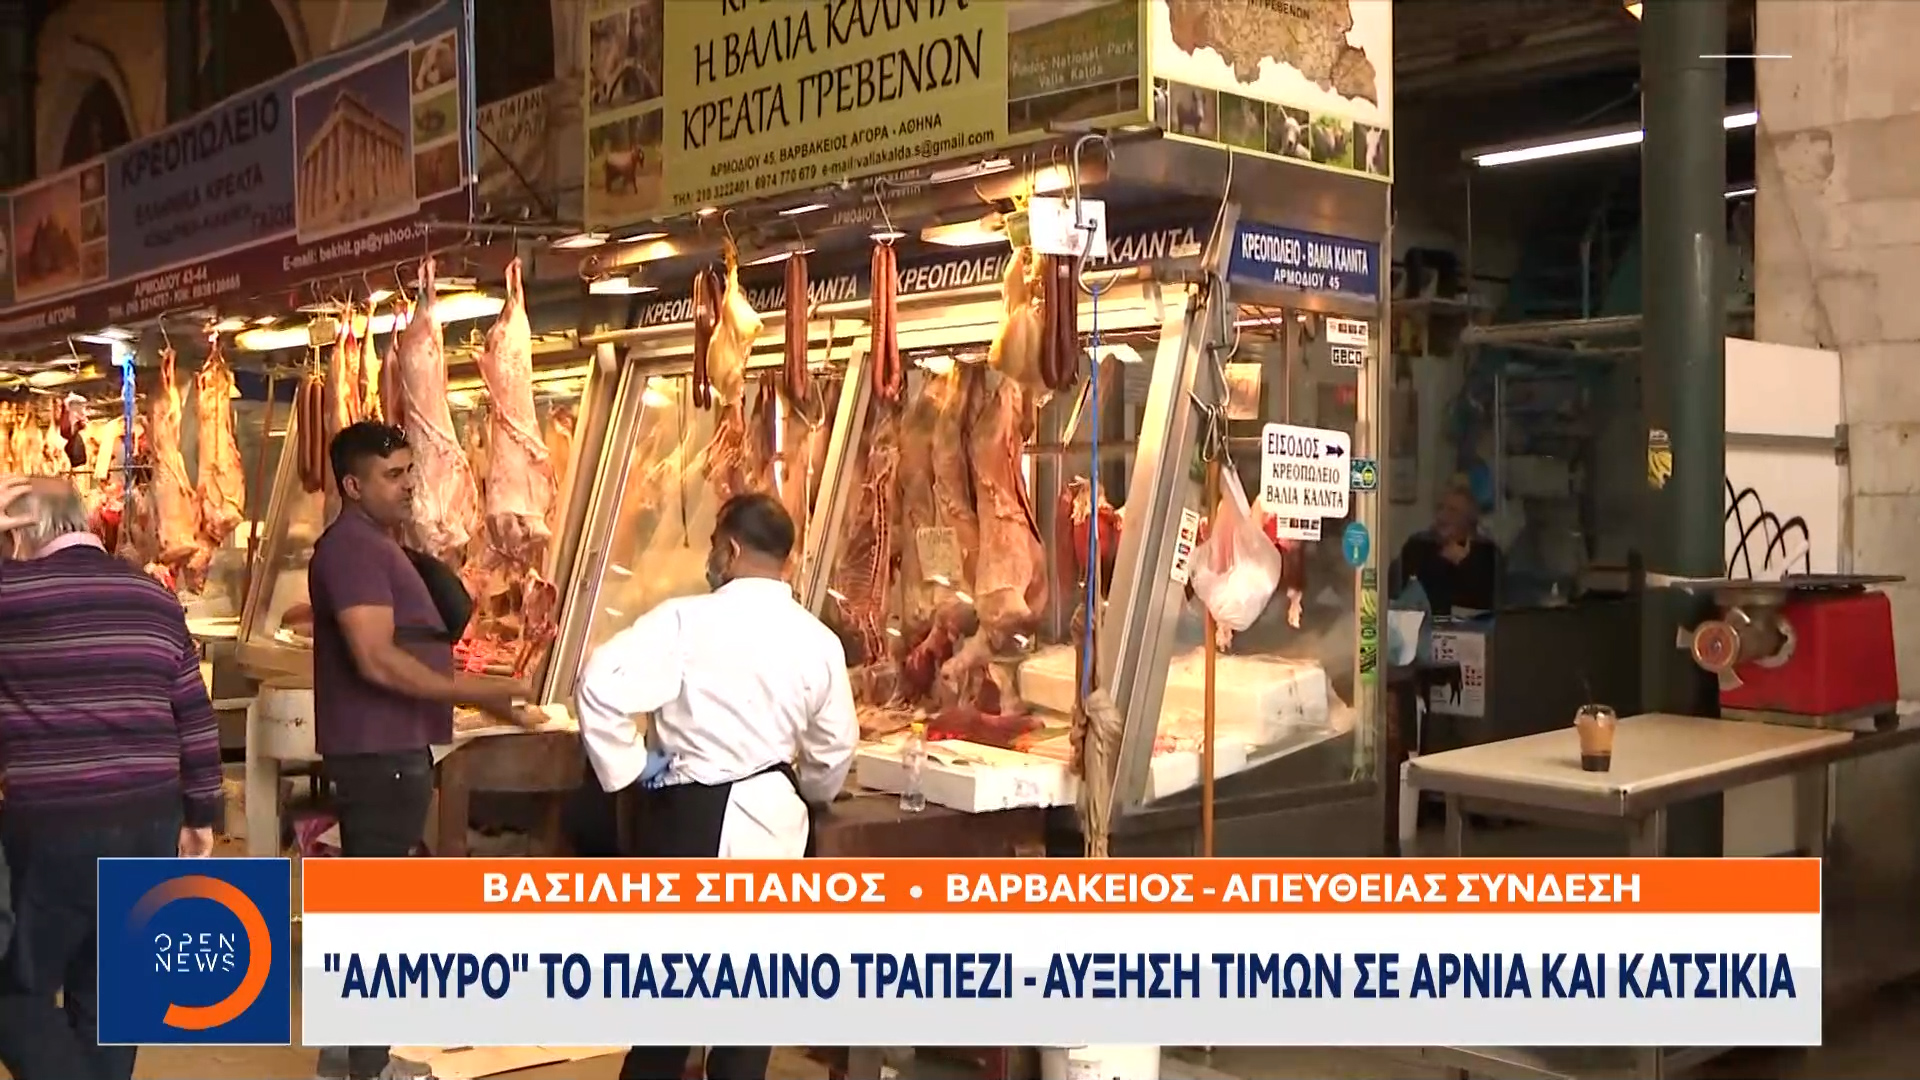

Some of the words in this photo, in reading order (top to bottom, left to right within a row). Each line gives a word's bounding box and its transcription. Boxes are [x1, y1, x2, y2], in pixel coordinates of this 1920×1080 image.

[693, 39, 717, 86] Η
[723, 10, 817, 77] ΒΑΛΙΑ
[1107, 40, 1135, 57] Park
[682, 83, 790, 150] ΚΡΕΑΤΑ
[797, 28, 983, 123] ΓΡΕΒΕΝΩΝ
[120, 91, 280, 189] ΚΡΕΟΠΩΛΕΙΟ
[711, 154, 762, 178] ΑΡΜΟΔΙΟΥ
[780, 134, 848, 162] ΒΑΡΒΑΚΕΙΟΣ
[851, 126, 889, 147] ΑΓΟΡΑ
[898, 114, 943, 136] ΑΘΗΝΑ
[1241, 232, 1301, 266] ΚΡΕΟΠΩΛΕΙΟ
[1307, 241, 1334, 269] ΒΑΛΙΑ
[1334, 245, 1370, 276] ΚΑΛΝΤΑ
[645, 297, 696, 325] ΚΡΕΟΠ
[806, 274, 858, 304] ΑΛΝΤΑ
[1273, 267, 1325, 288] ΑΡΜΟΔΙΟΥ
[1328, 275, 1341, 291] 45
[1268, 433, 1320, 459] ΕΙΣΟΔΟΣ
[1272, 463, 1340, 484] ΚΡΕΟΠΩΛΕΙΟ
[1266, 485, 1299, 505] ΒΑΛΙΑ
[1303, 488, 1344, 509] ΚΑΛΝΤΑ
